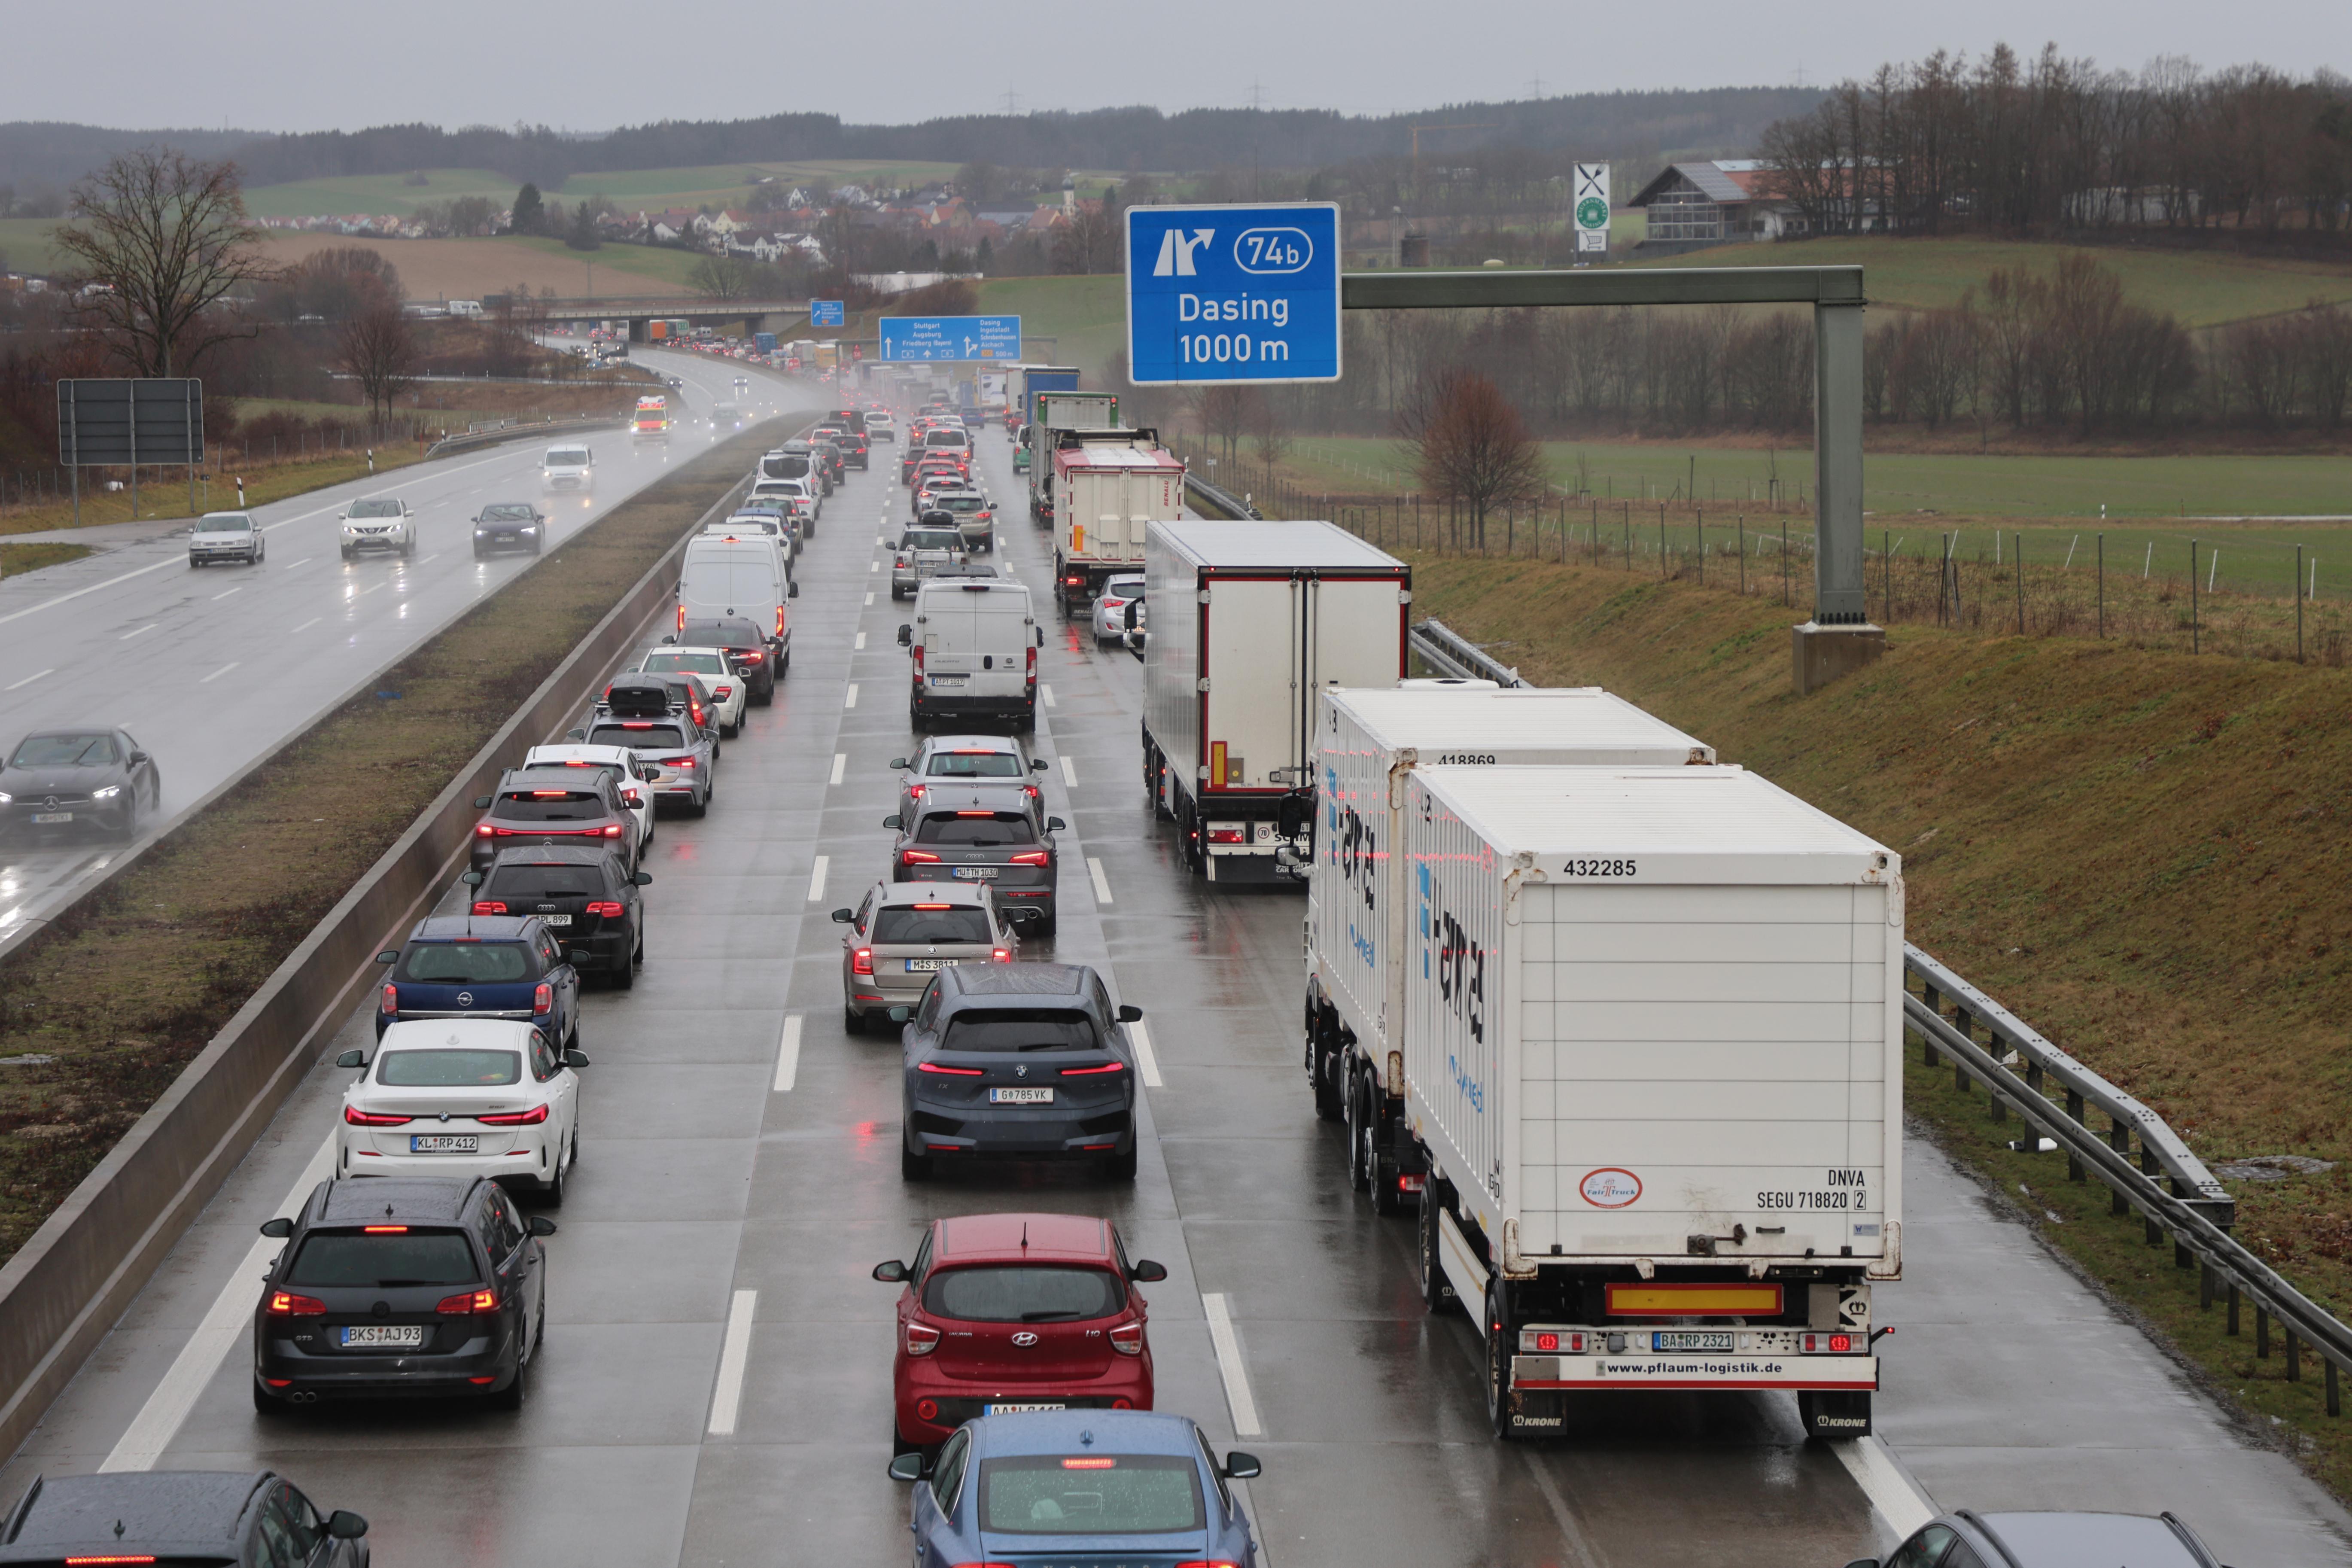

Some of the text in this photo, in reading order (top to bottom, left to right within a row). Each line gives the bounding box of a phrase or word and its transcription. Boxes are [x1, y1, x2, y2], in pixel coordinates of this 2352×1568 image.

[1248, 237, 1299, 265] 74b
[1180, 292, 1288, 326] Dasing
[1181, 334, 1288, 362] 1000 m
[1439, 755, 1495, 764] 418869
[1564, 860, 1636, 876] 432285
[914, 960, 953, 969] M S 3811
[1002, 1090, 1046, 1099] G 785 VK
[418, 1138, 475, 1148] KL RP 412
[1829, 1169, 1865, 1186] DNVA
[1758, 1192, 1793, 1208] SEGU
[1799, 1192, 1847, 1208] 718820
[350, 1327, 420, 1341] BKS AJ 93
[1661, 1334, 1731, 1347] BA RP 2321
[1607, 1363, 1782, 1374] www.pflaum-logistik.de
[1524, 1418, 1562, 1426] KRONE
[1829, 1418, 1866, 1427] KRONE
